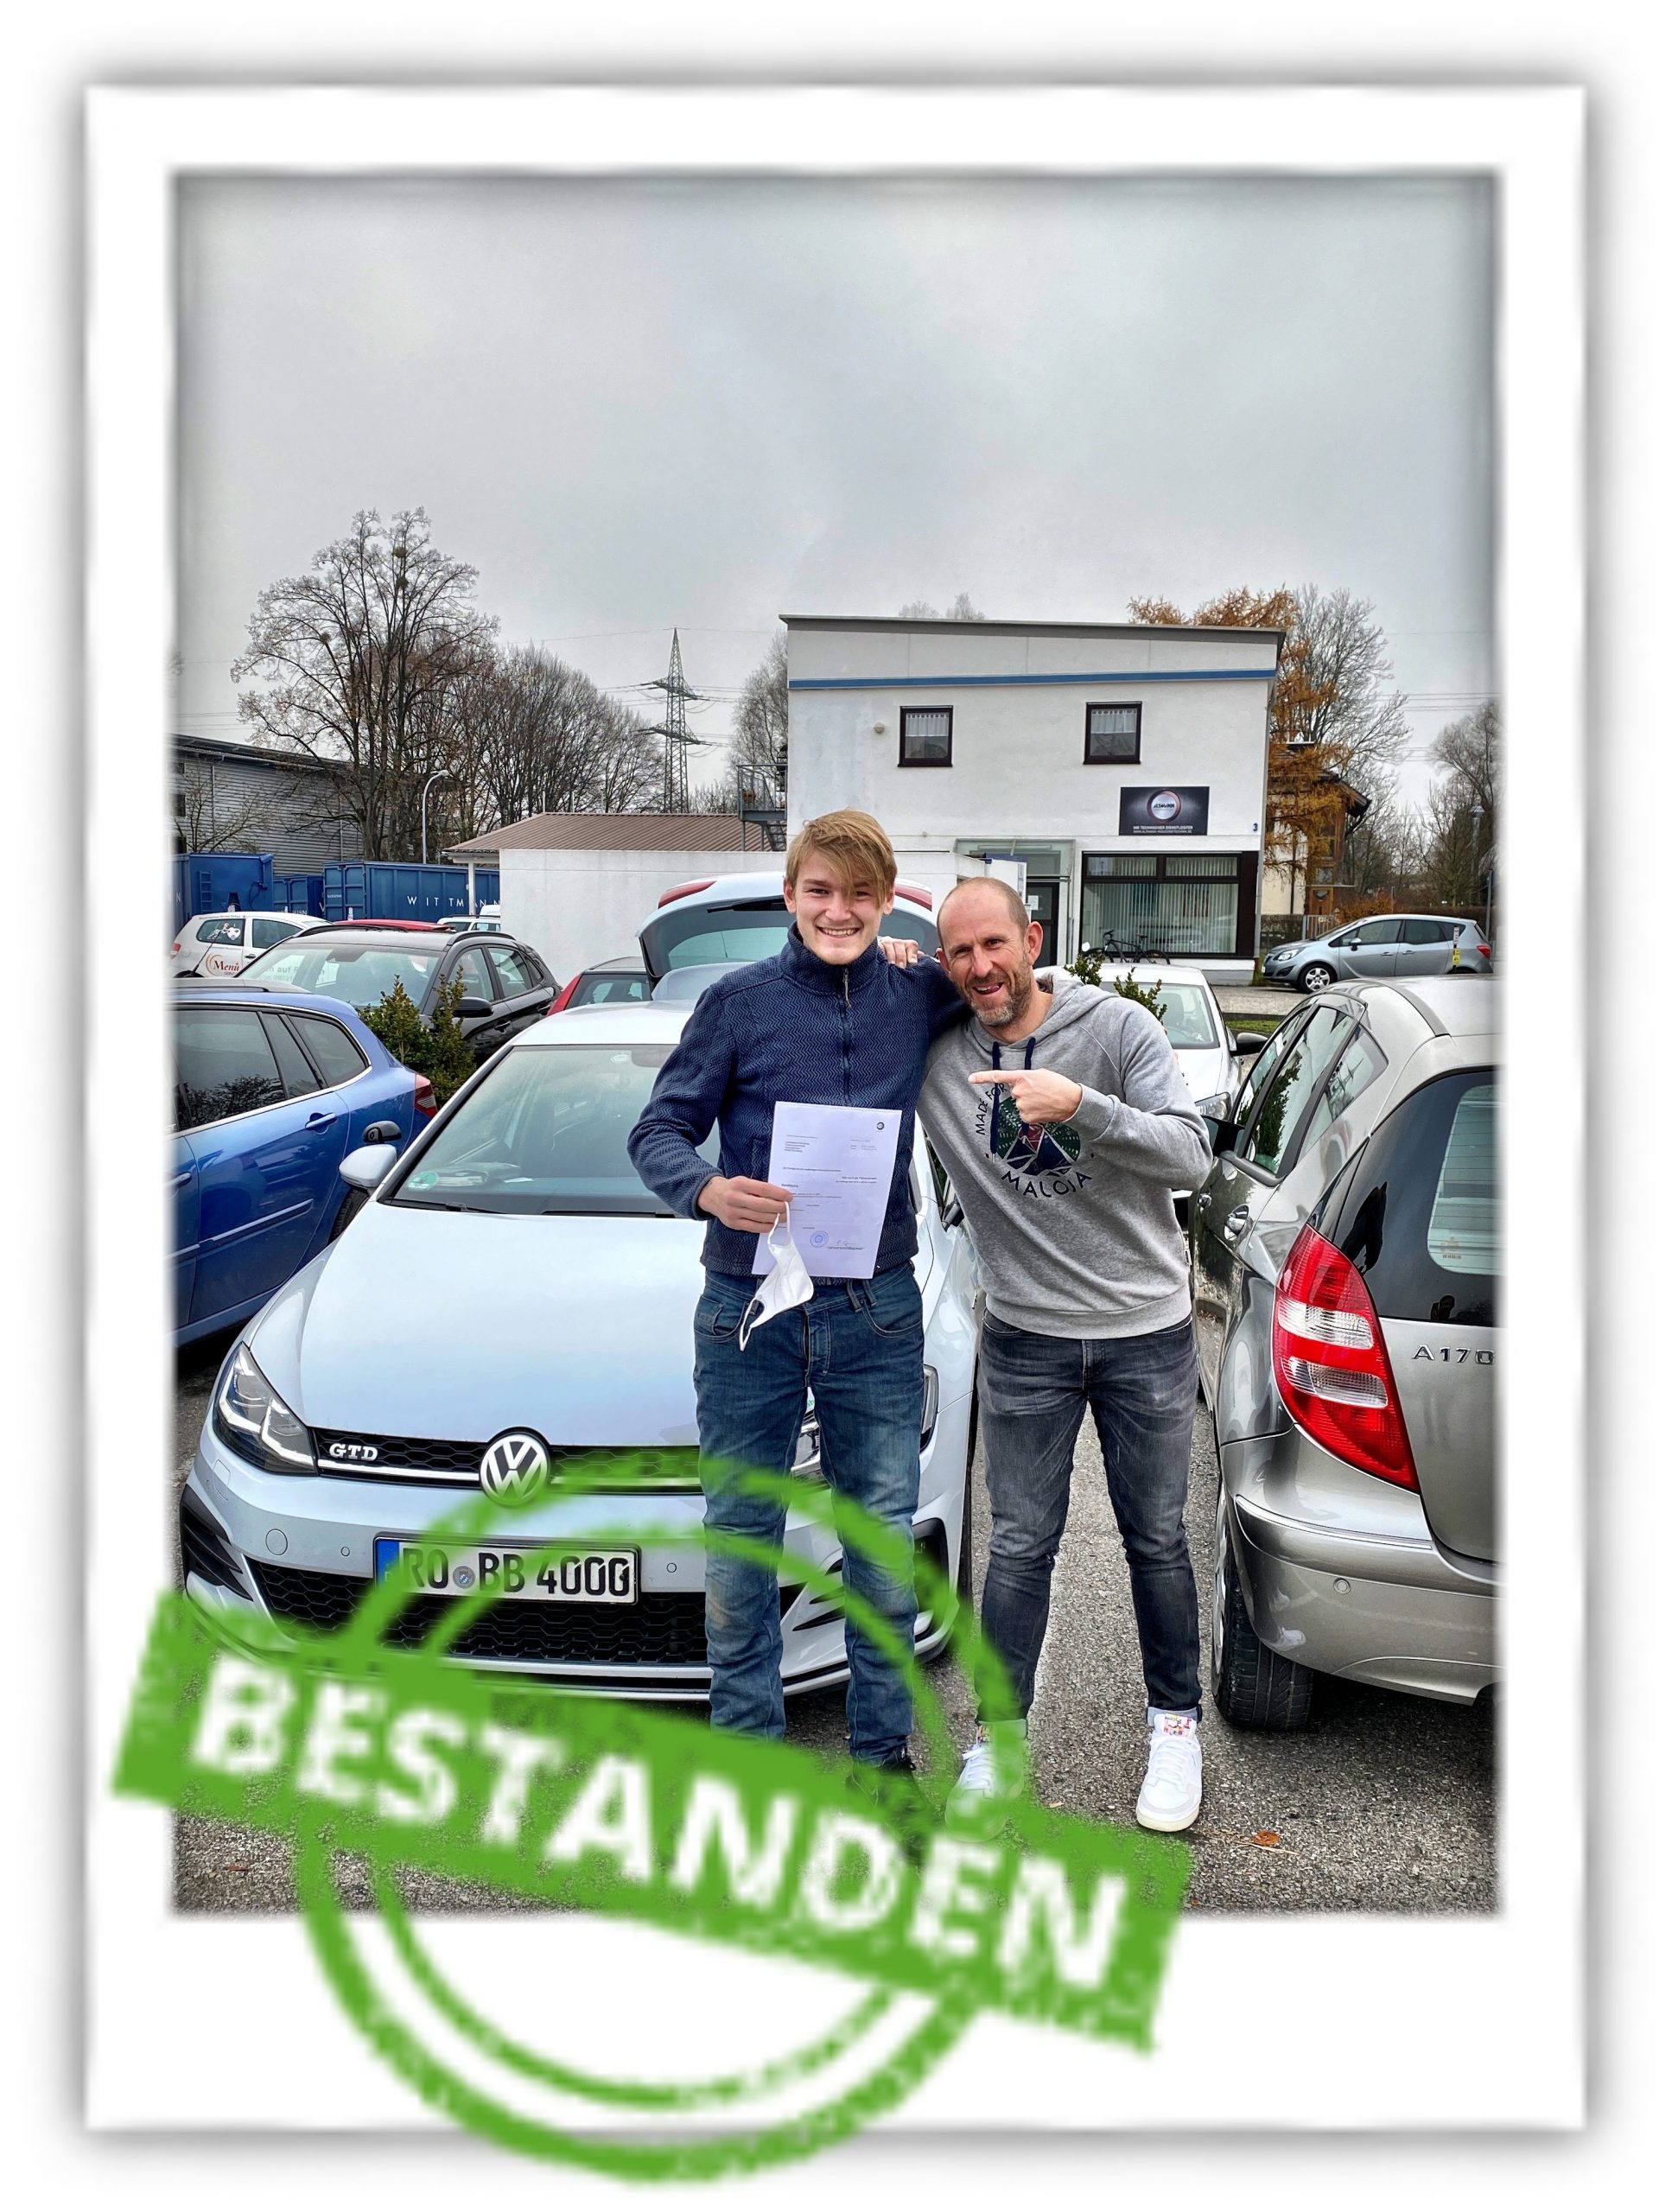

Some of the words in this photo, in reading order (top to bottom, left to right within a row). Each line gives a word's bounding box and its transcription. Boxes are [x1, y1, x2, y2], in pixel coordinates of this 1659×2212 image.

[975, 1097, 988, 1135] MADE
[328, 1443, 378, 1462] GTD
[403, 1547, 449, 1590] RO
[478, 1552, 525, 1593] BB
[536, 1554, 631, 1597] 4000
